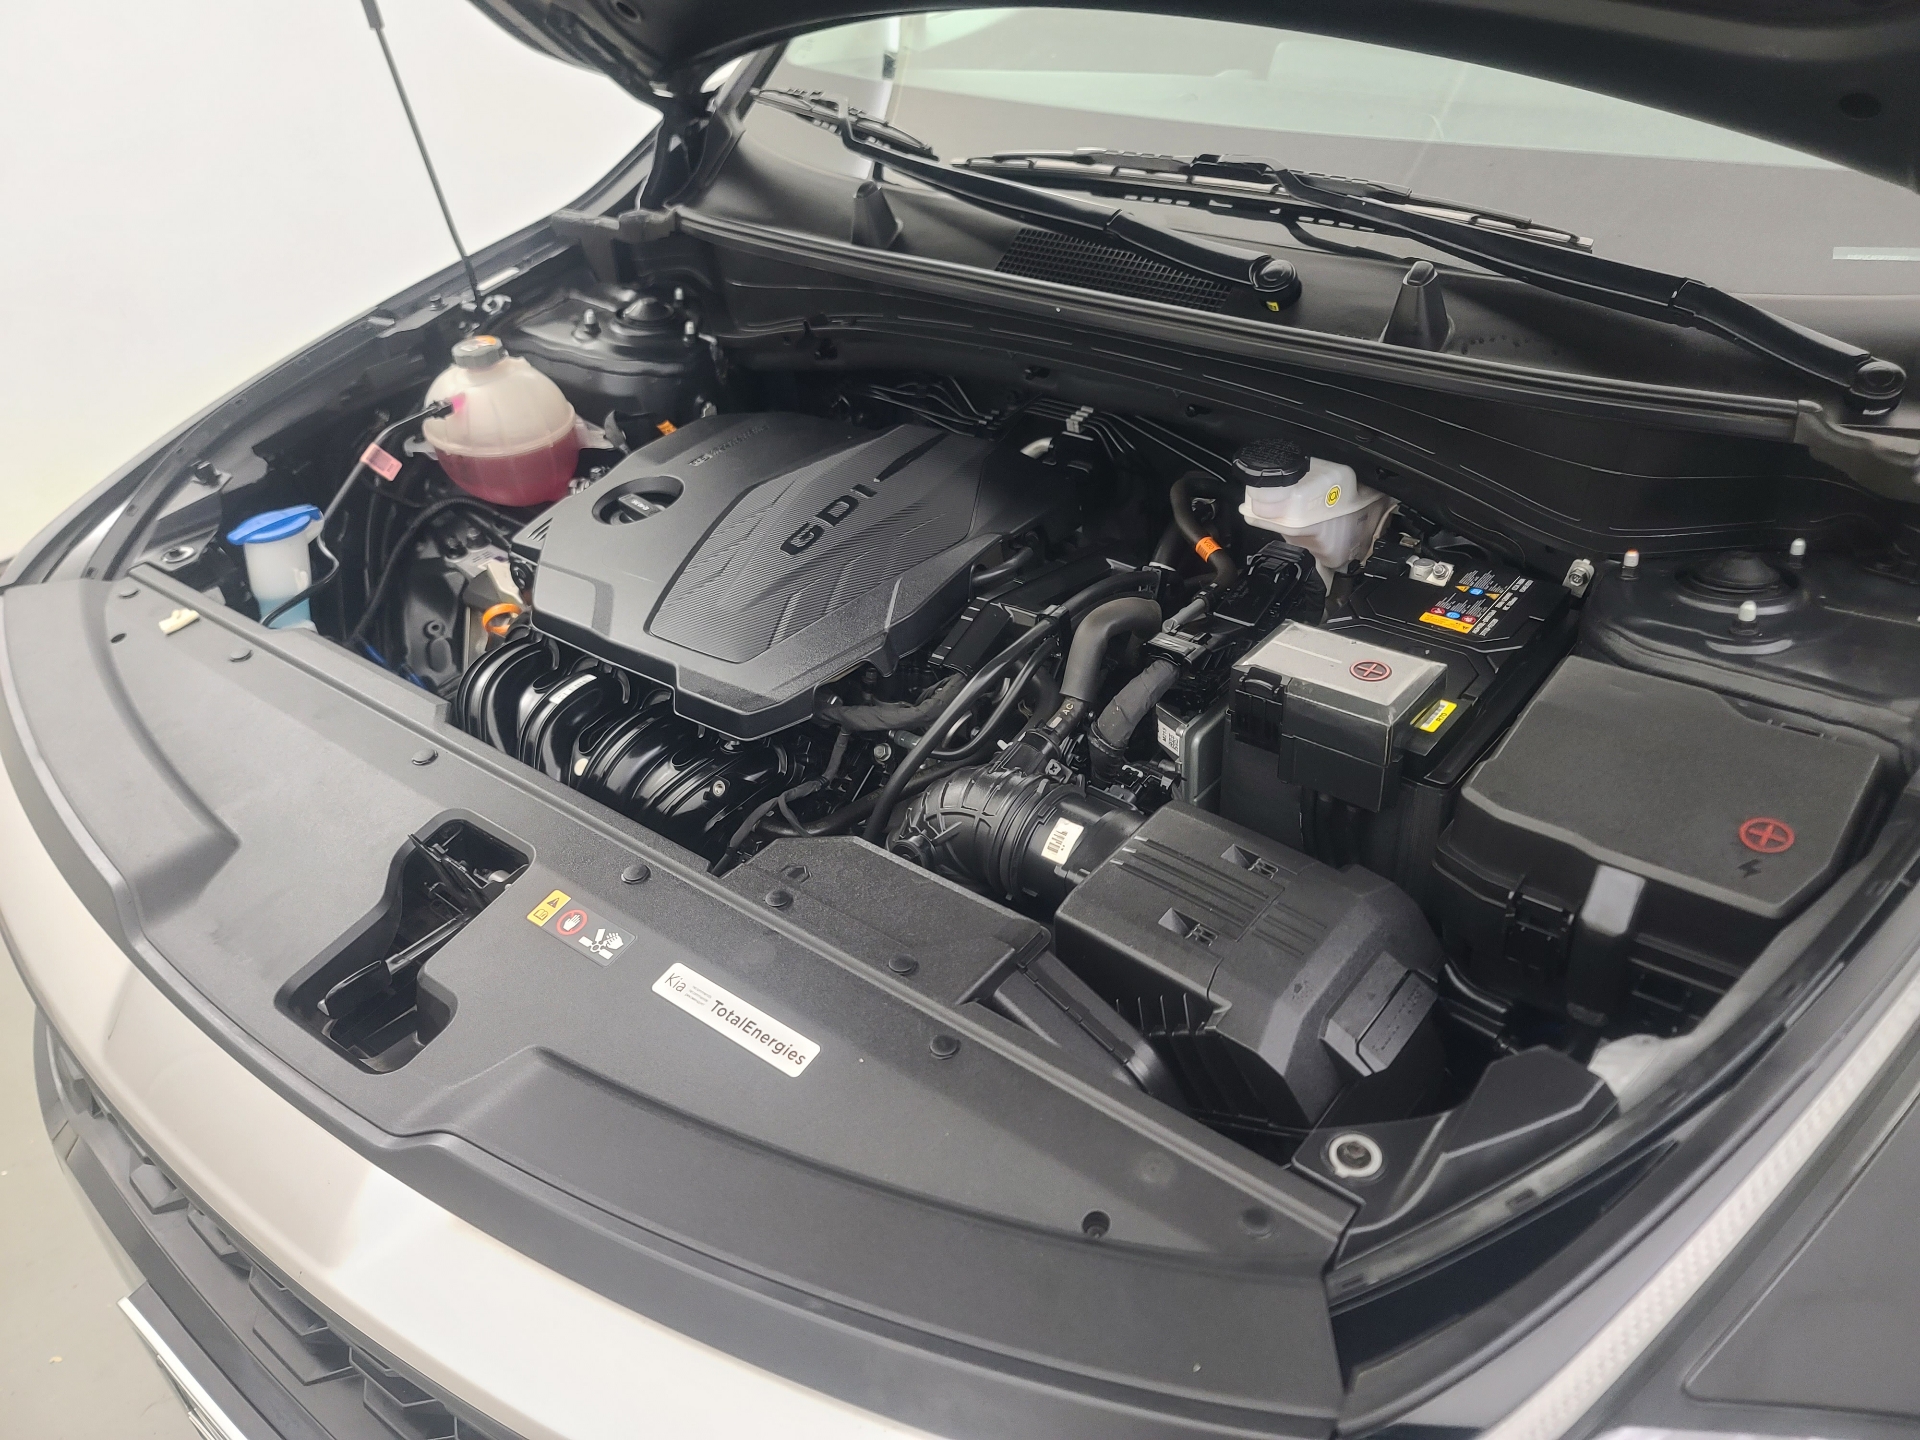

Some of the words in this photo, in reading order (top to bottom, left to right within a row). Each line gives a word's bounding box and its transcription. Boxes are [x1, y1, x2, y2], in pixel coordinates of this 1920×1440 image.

[780, 484, 877, 555] GDI
[664, 972, 687, 993] Kia
[710, 1000, 806, 1066] TotalEnergies
